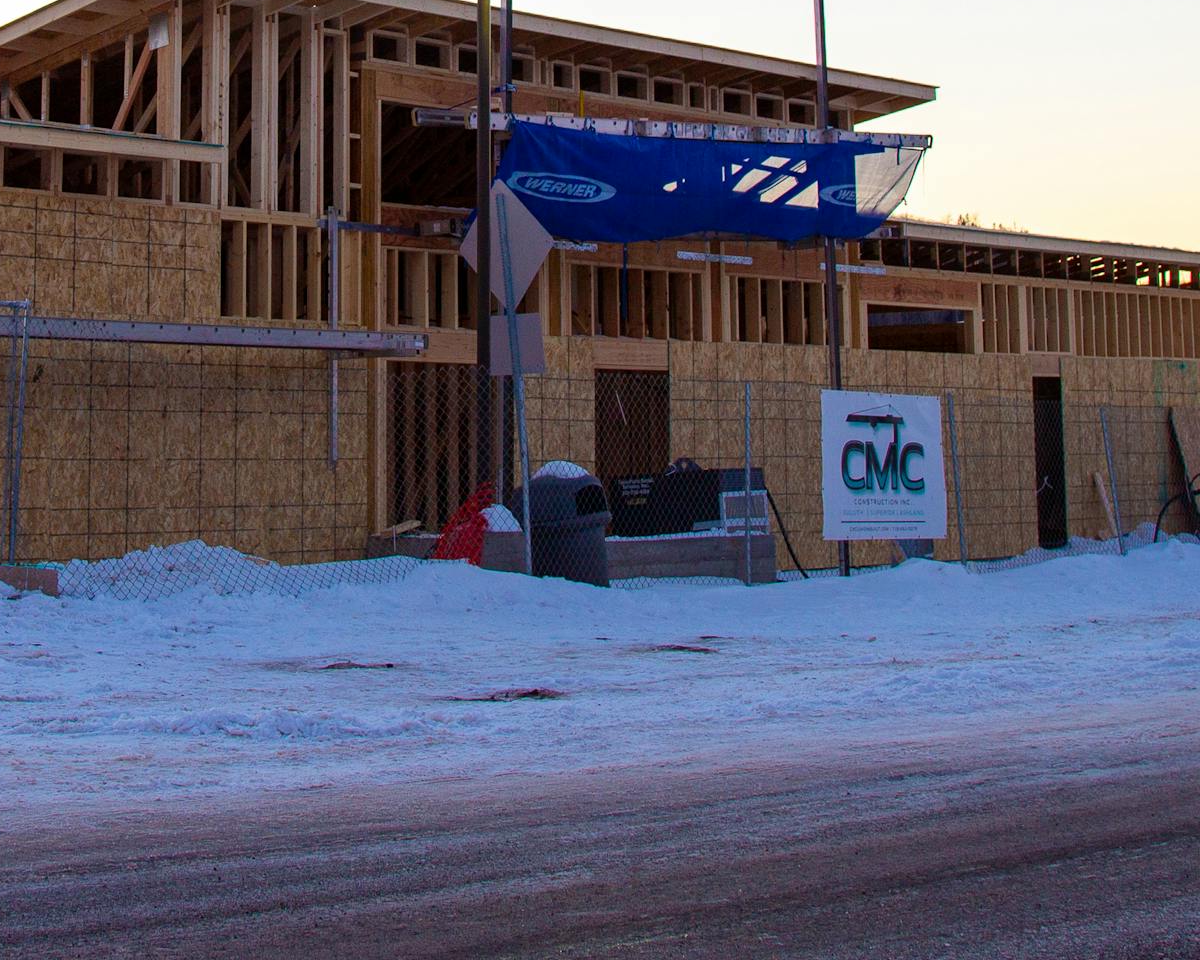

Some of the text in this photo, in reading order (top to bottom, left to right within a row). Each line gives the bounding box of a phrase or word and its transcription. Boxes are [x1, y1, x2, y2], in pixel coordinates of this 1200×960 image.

[524, 177, 598, 198] WERNER
[841, 440, 925, 491] CMC
[854, 498, 899, 506] CONSTRUCTION
